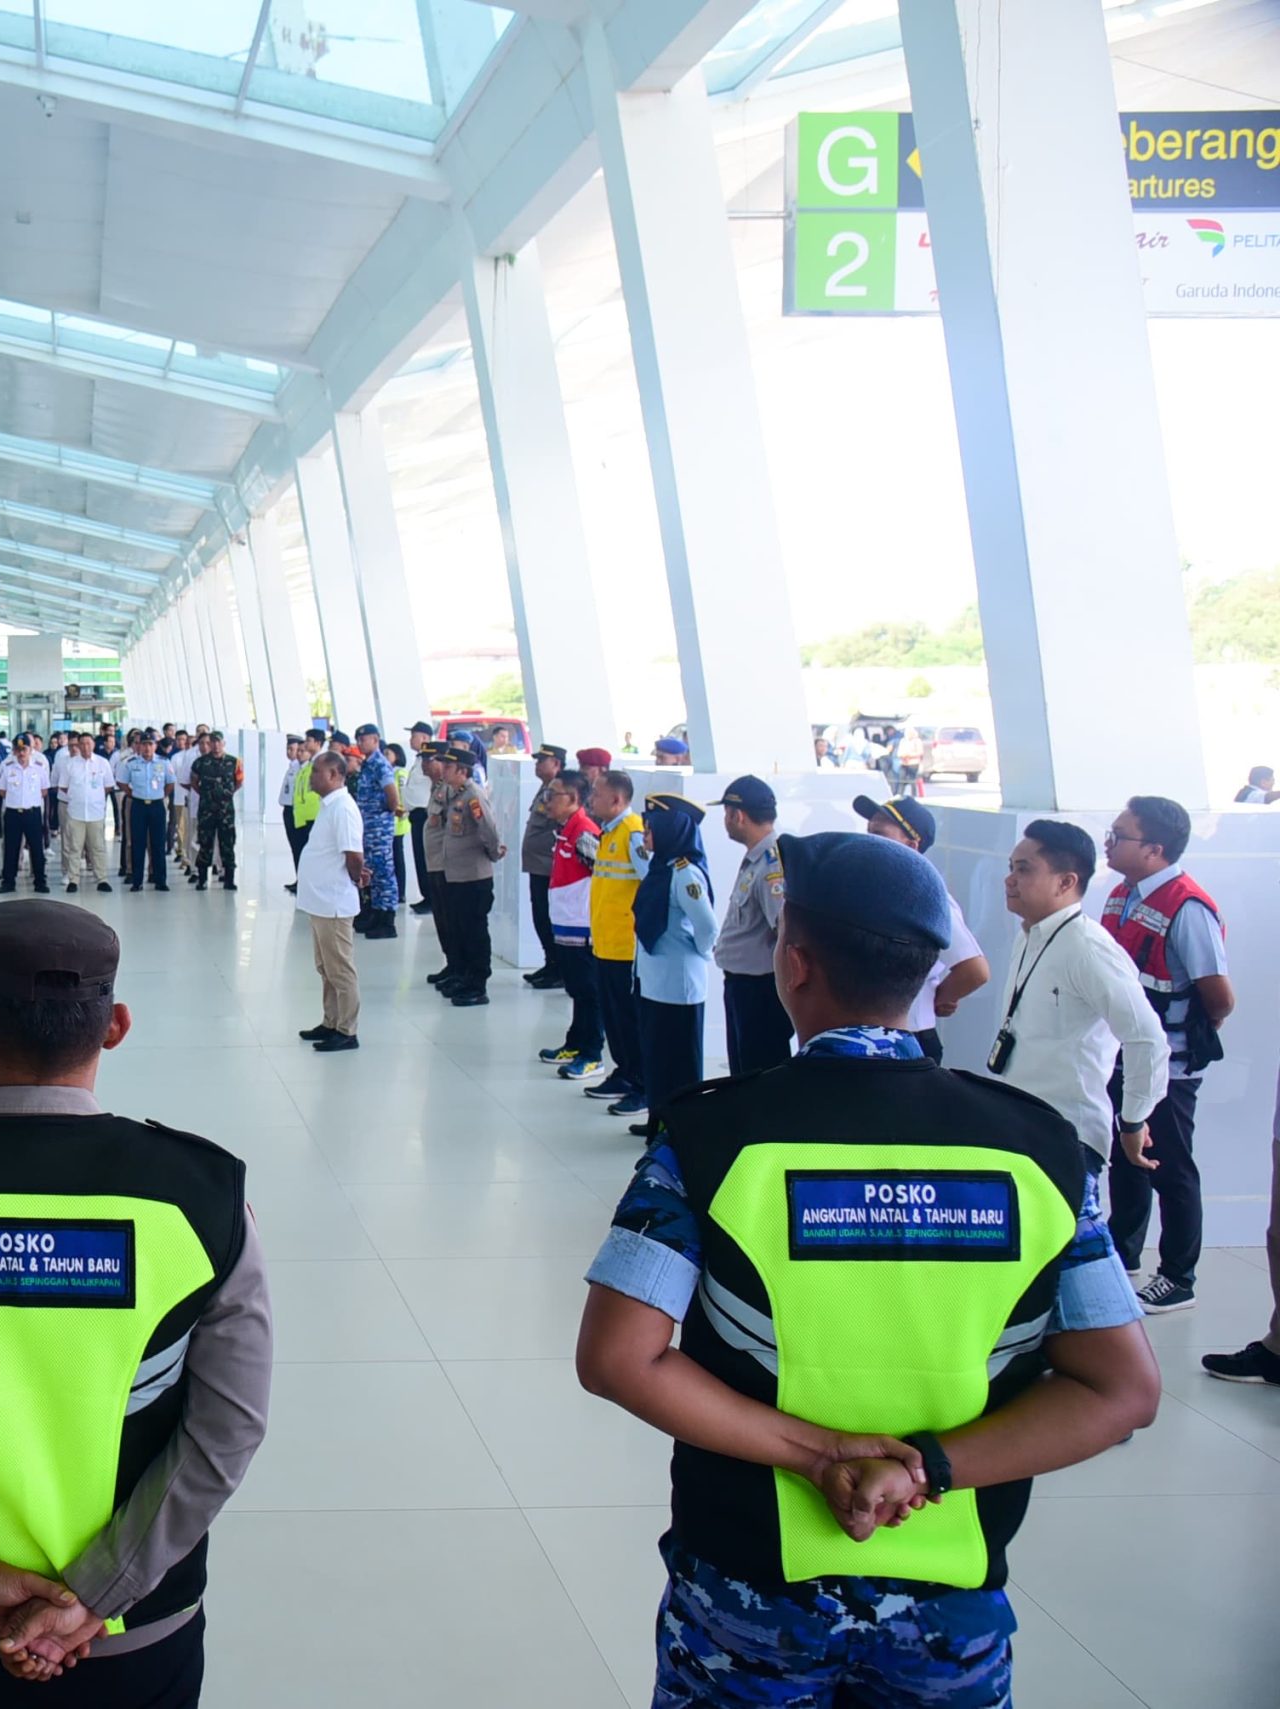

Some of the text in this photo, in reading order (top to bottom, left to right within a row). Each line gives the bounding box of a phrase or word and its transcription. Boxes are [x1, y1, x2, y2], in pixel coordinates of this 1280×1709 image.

[816, 125, 880, 197] G
[824, 230, 871, 297] 2
[1175, 283, 1229, 299] Garuda
[864, 1183, 937, 1204] POSKO
[803, 1207, 1004, 1225] ANGKUTAN NATAL & TAHUN BARU
[803, 1228, 837, 1238] BANDAR
[839, 1228, 867, 1238] UDARA
[904, 1228, 952, 1239] SEPINGGAN
[954, 1229, 1005, 1240] BALIKPAPAN
[29, 1258, 39, 1273] &
[42, 1257, 84, 1273] TAHUN
[87, 1258, 120, 1274] BARU
[20, 1277, 69, 1287] SEPINGGAN
